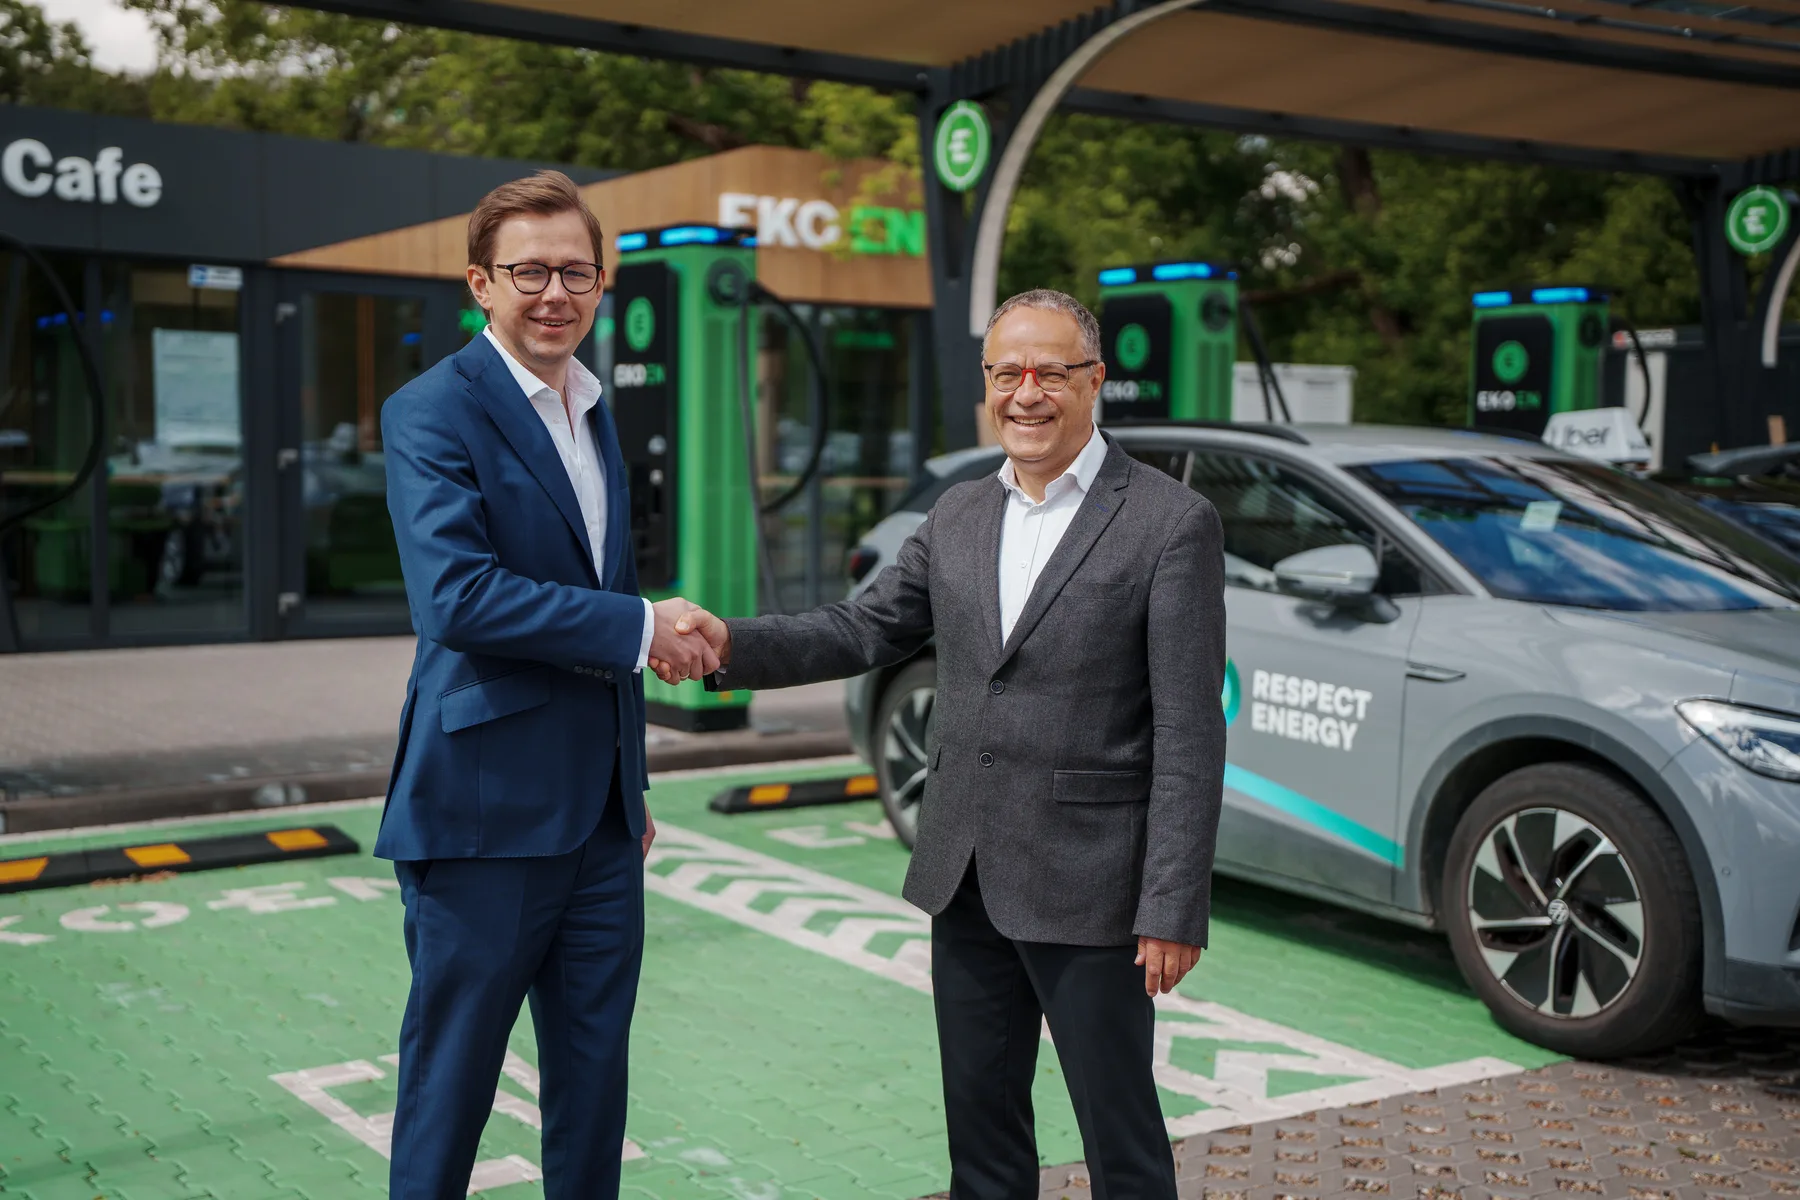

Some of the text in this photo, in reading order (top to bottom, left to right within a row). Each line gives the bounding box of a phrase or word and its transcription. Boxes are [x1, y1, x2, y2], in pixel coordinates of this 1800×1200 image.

[2, 138, 163, 208] Cafe
[1252, 668, 1373, 721] RESPECT
[1251, 701, 1358, 751] ENERGY
